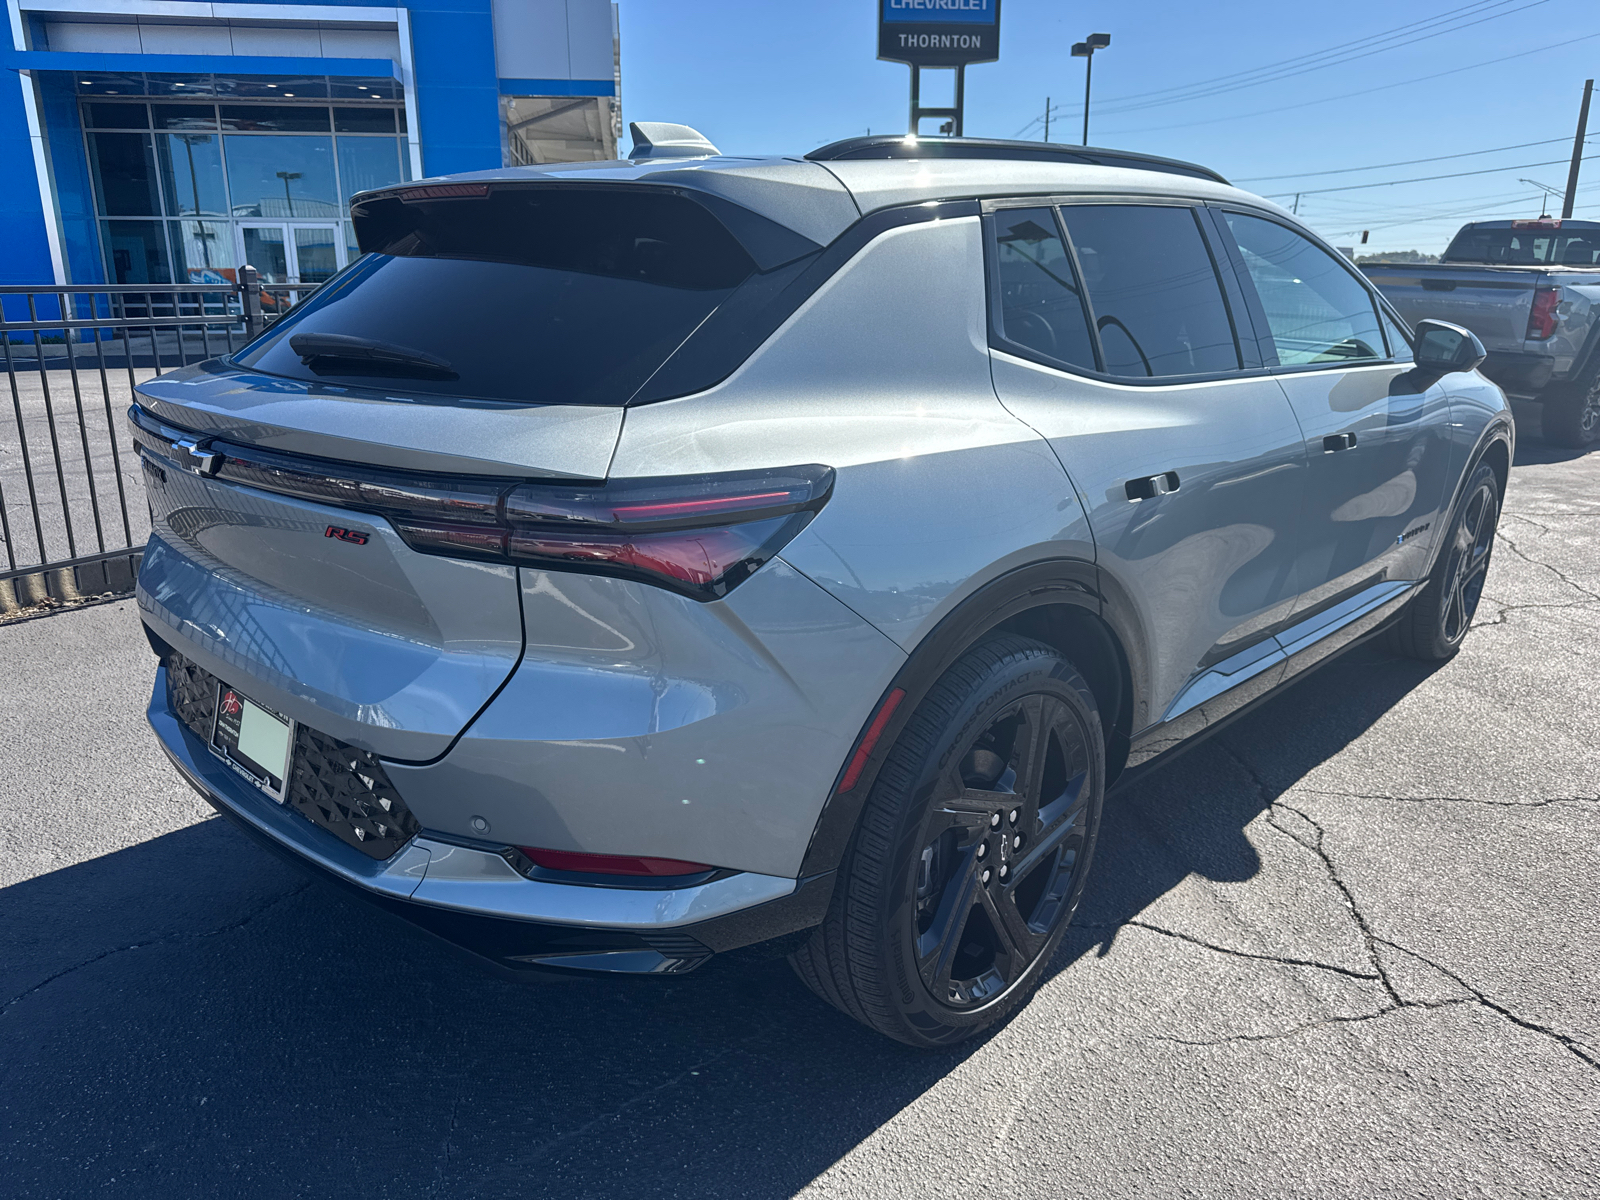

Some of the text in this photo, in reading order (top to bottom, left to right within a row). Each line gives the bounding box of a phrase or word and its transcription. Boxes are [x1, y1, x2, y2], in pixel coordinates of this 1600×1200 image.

[890, 0, 987, 10] CHEVROLET
[898, 34, 981, 48] THORNTON
[325, 525, 370, 545] RS
[231, 763, 255, 783] CHEVROLET
[890, 941, 915, 1005] Continental
